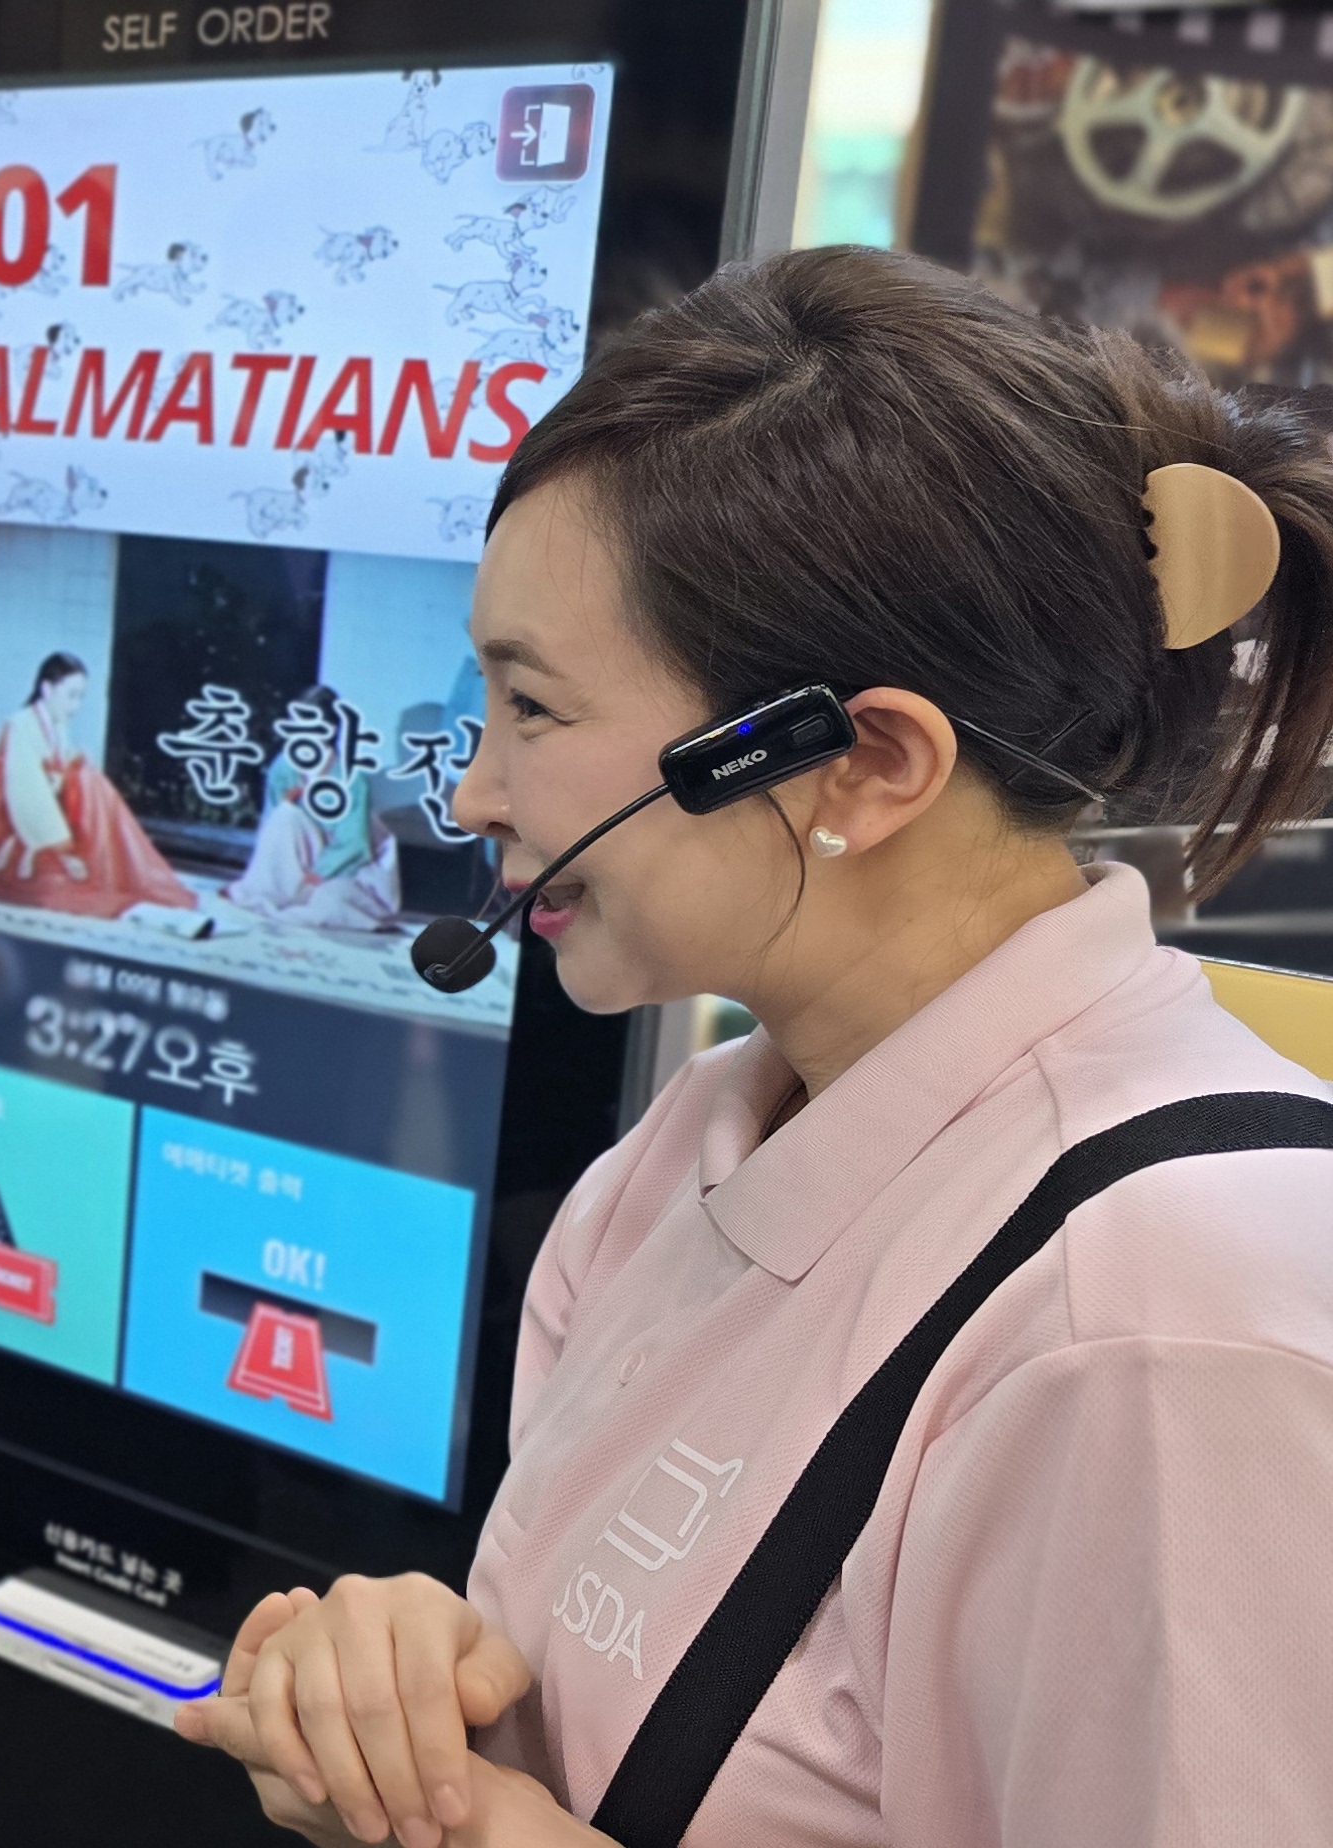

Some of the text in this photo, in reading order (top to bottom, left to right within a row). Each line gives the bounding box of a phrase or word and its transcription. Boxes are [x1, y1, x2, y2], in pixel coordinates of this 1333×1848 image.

[101, 3, 331, 51] SELF ORDER
[156, 683, 486, 842] 춘향전
[711, 749, 768, 780] NEKO
[26, 995, 258, 1105] 3:27오후
[262, 1238, 326, 1292] OK!
[44, 1521, 114, 1566] 신용카드
